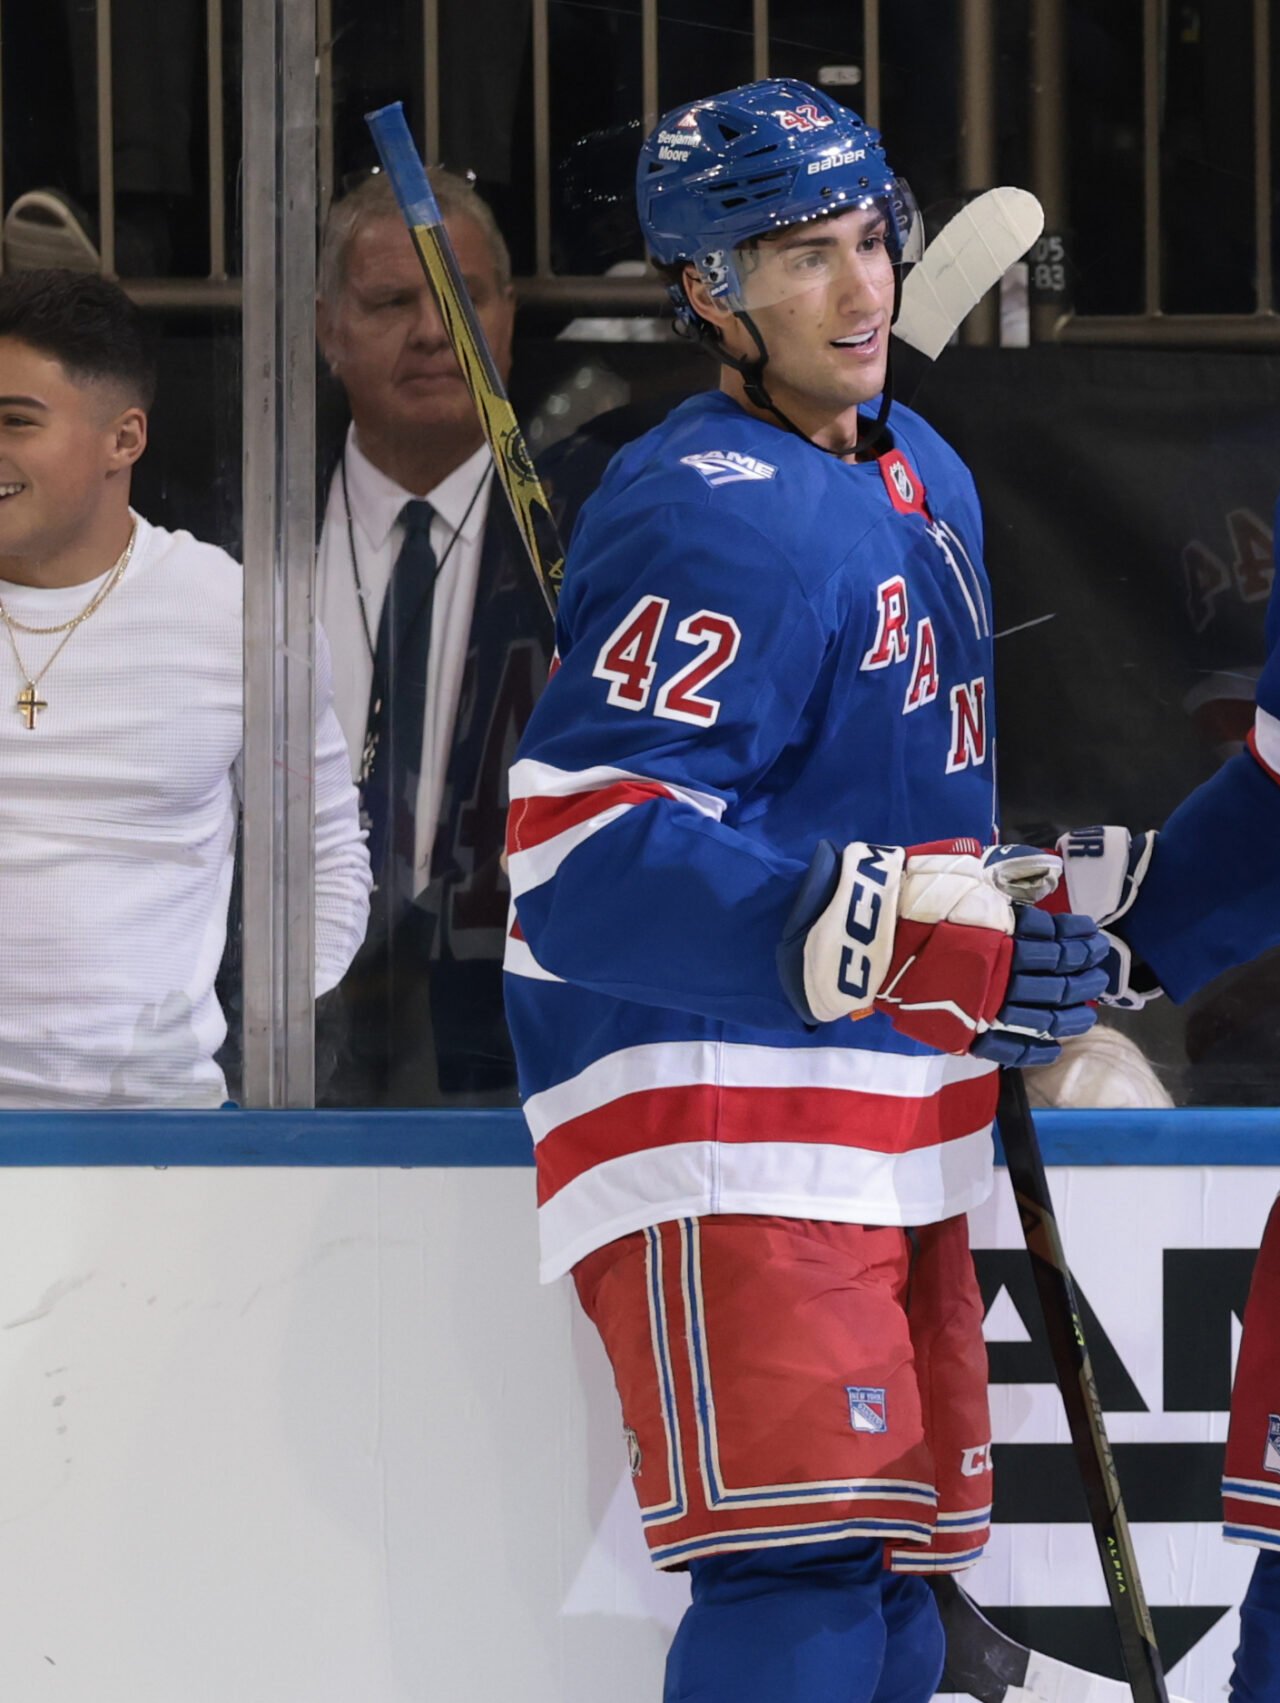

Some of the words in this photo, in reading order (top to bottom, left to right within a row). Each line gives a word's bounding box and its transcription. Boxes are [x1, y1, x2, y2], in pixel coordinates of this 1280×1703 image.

[775, 104, 834, 132] 42
[658, 130, 701, 148] Benjamin
[658, 146, 690, 162] Moore
[592, 594, 741, 728] 42
[837, 844, 898, 999] CCM
